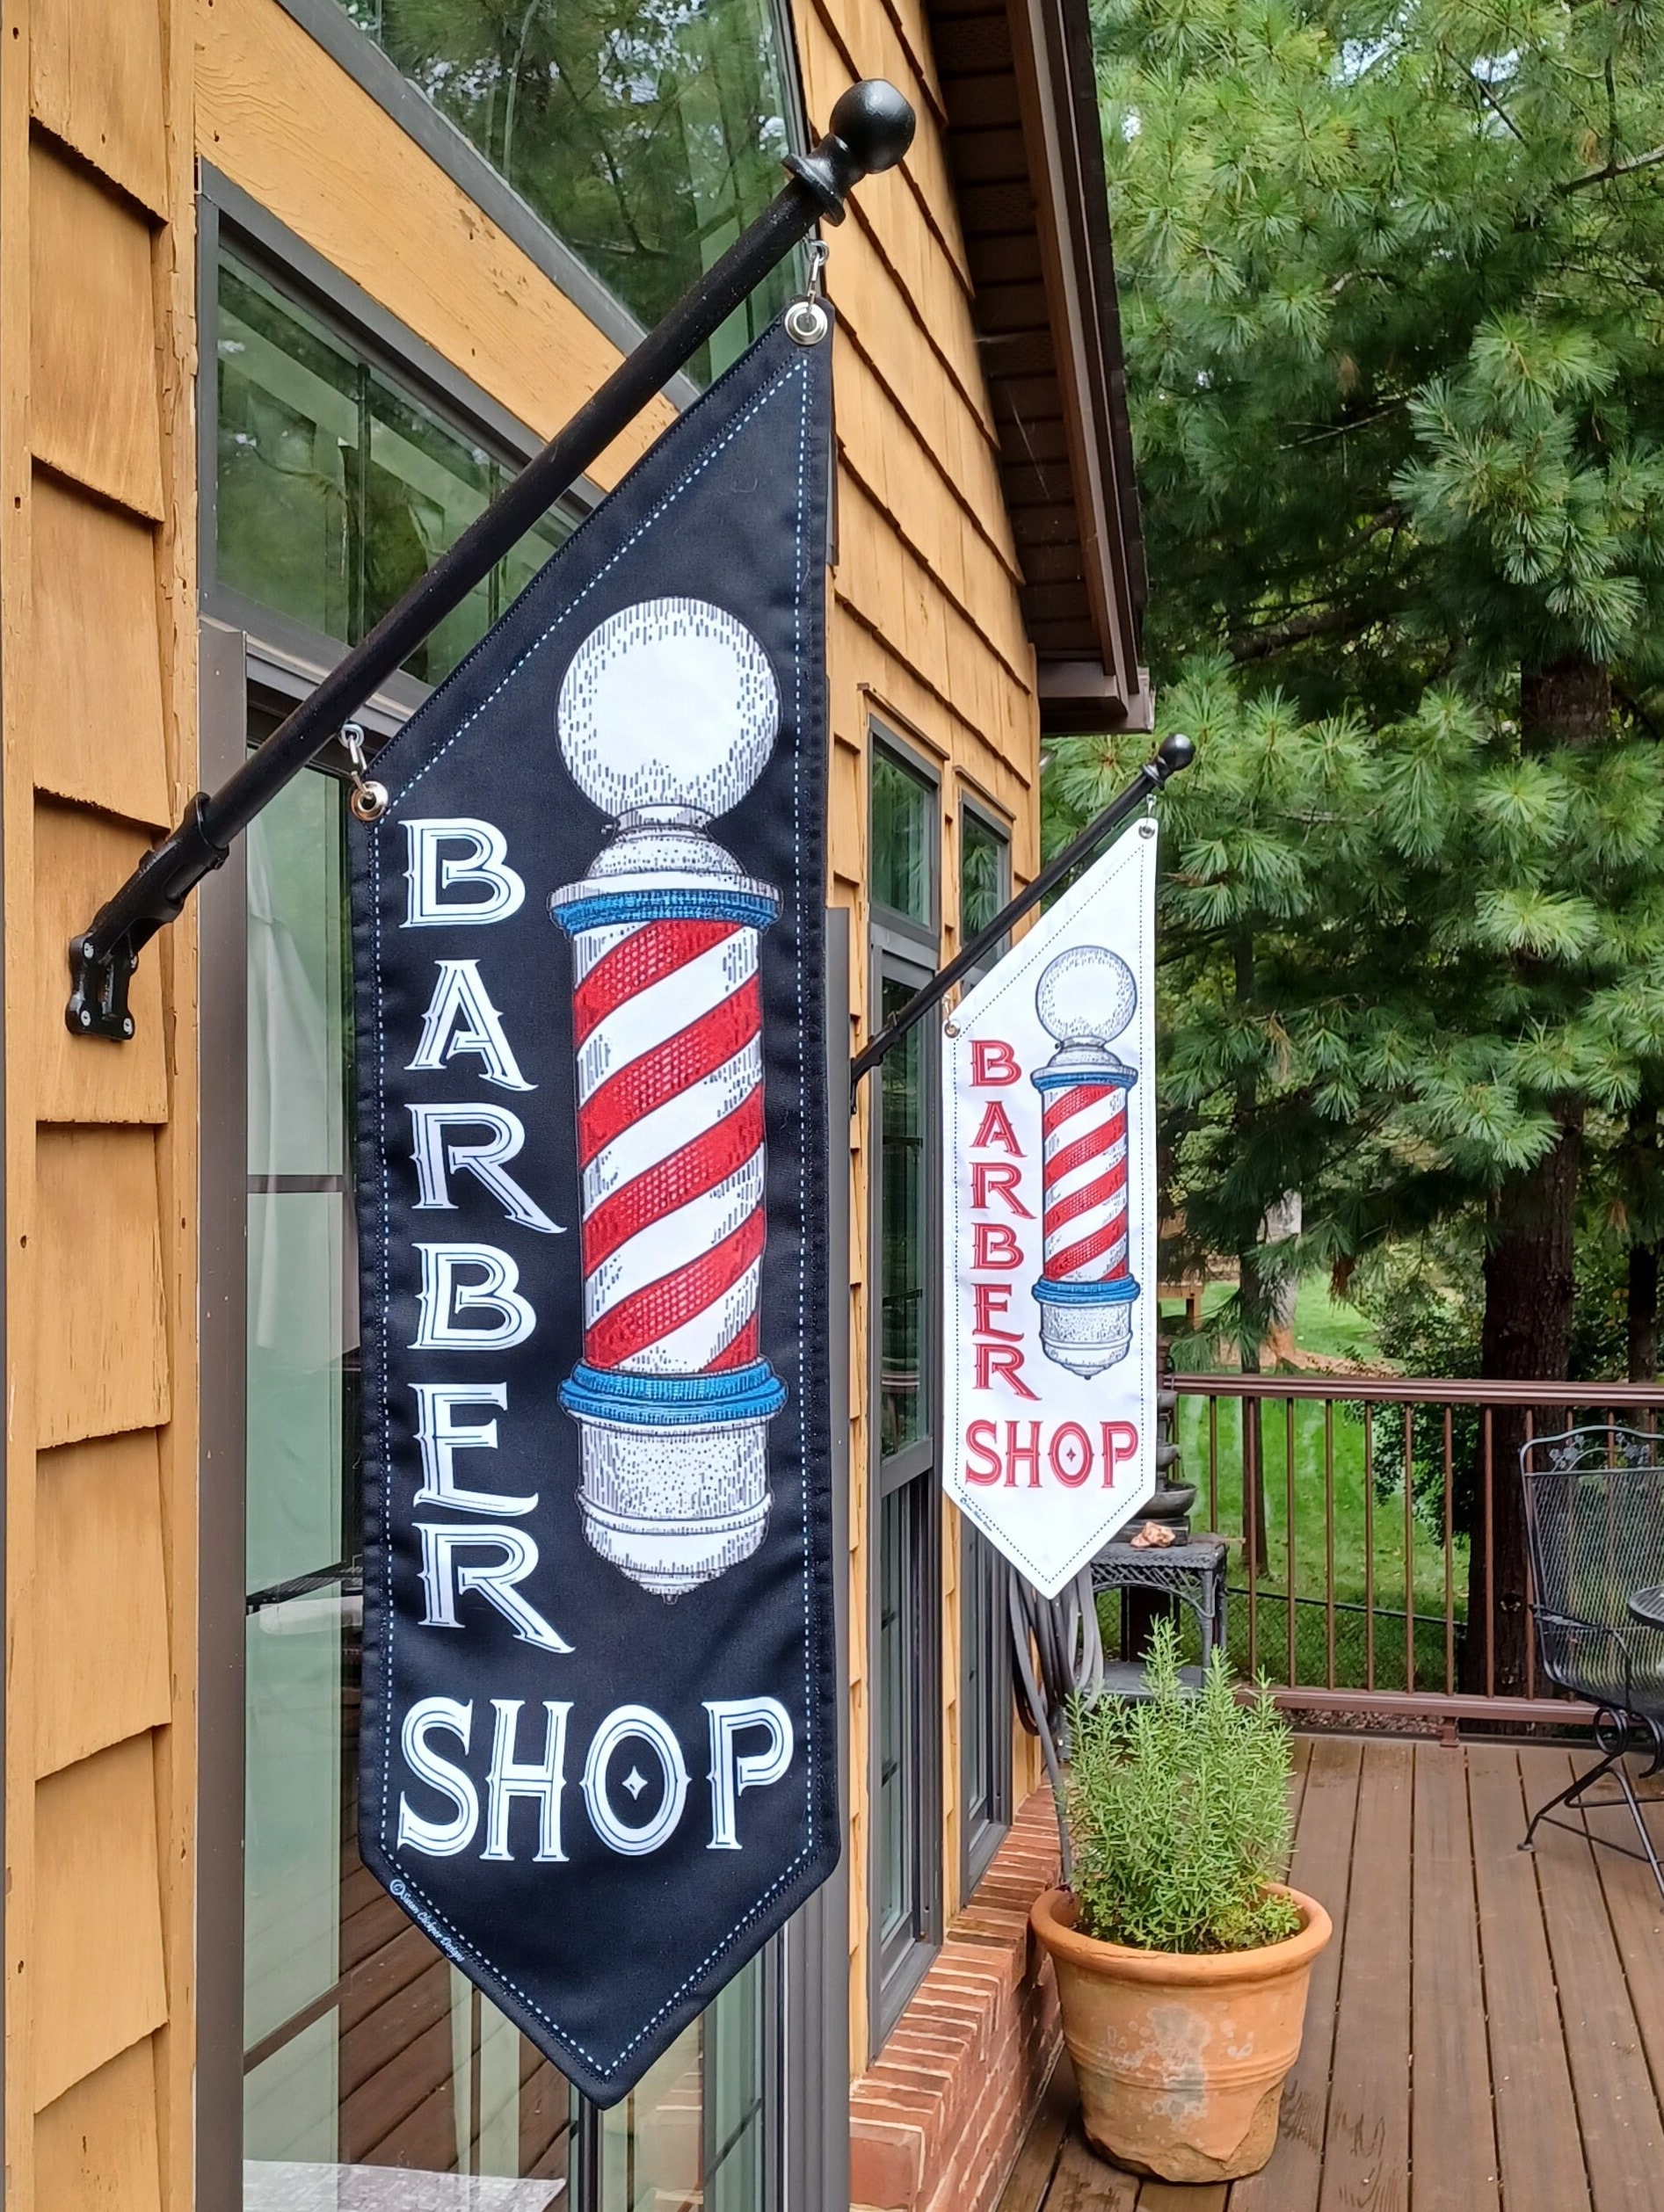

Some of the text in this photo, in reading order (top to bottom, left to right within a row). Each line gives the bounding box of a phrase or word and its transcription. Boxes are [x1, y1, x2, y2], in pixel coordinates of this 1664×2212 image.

[397, 817, 576, 1654] BARBER
[969, 1039, 1042, 1402] BARBER
[965, 1418, 1139, 1489] SHOP
[396, 1695, 795, 1863] SHOP
[440, 1937, 465, 1962] Designs
